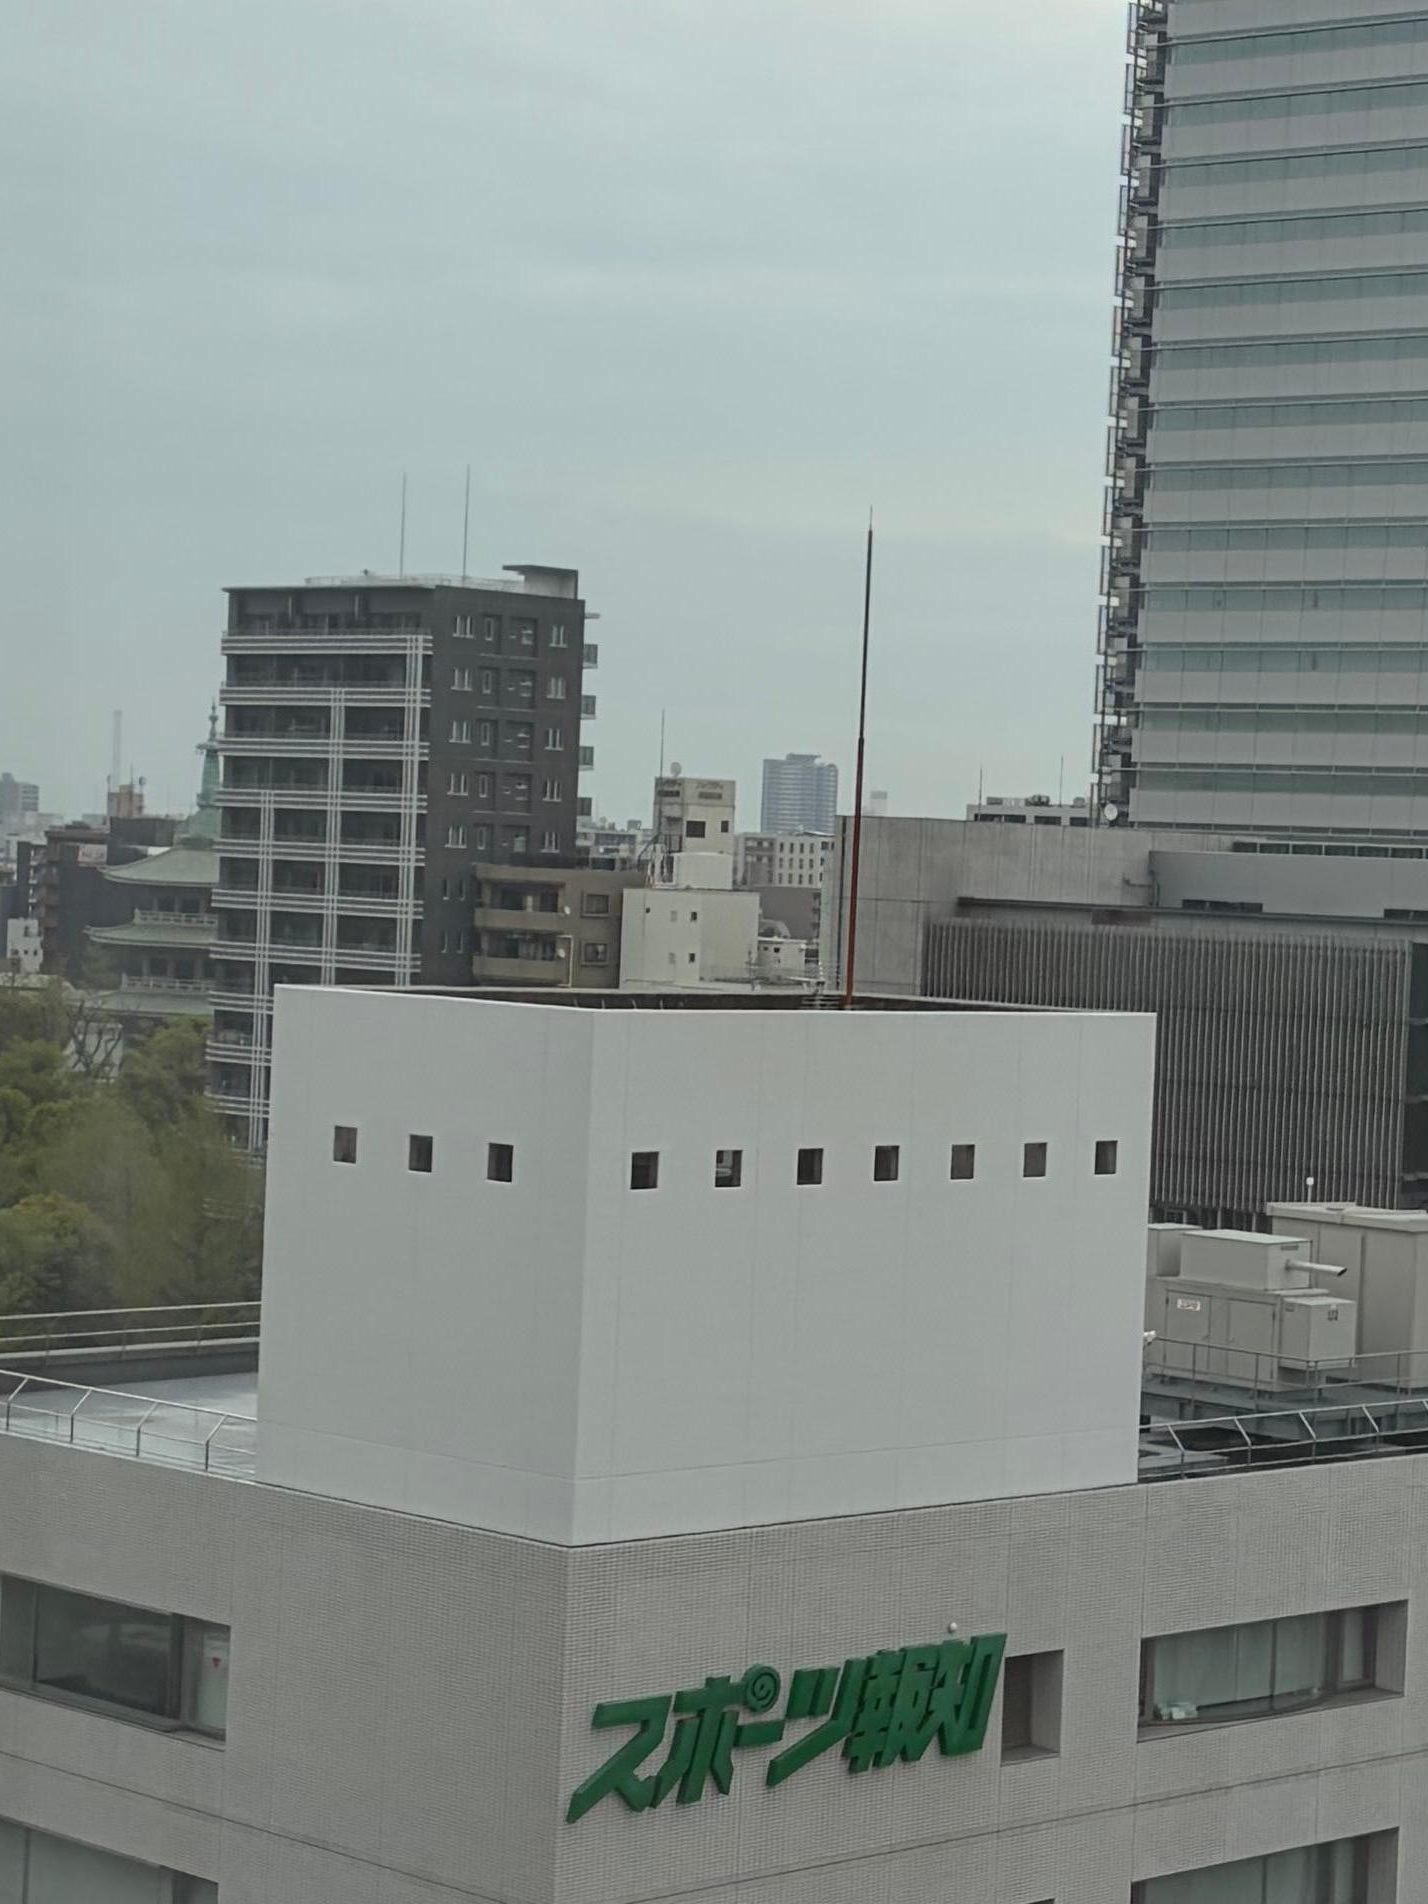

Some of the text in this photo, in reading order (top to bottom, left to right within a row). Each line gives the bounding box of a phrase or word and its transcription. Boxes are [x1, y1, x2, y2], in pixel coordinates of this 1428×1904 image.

[566, 1632, 1007, 1824] スポーツ報知
